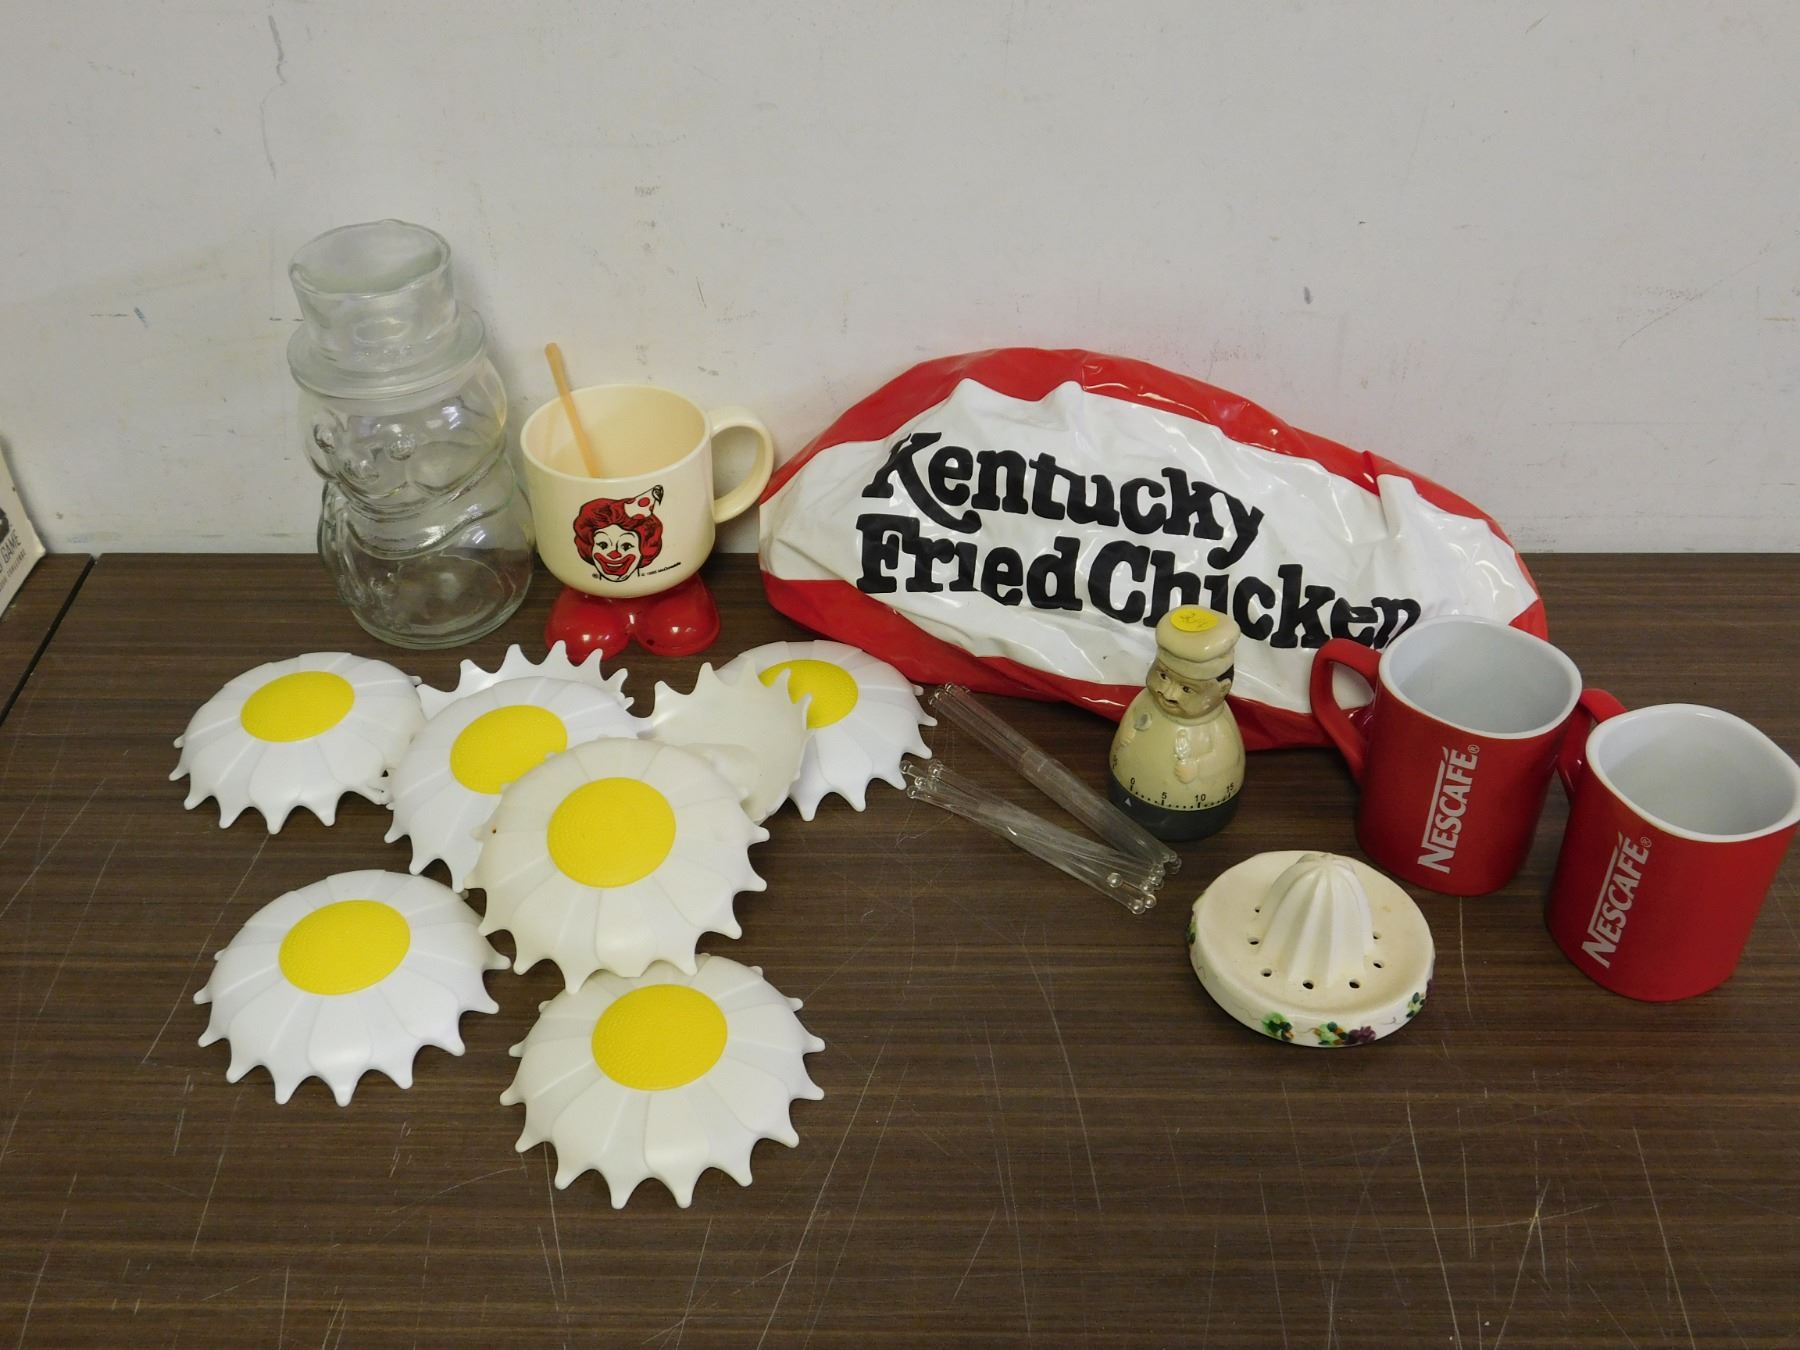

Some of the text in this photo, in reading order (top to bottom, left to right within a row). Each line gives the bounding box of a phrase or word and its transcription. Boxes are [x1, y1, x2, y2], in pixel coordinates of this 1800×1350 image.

[861, 432, 1264, 570] Kentucky
[1, 528, 22, 564] GAME
[856, 513, 1422, 649] Fried Chicken
[1194, 793, 1206, 802] 10
